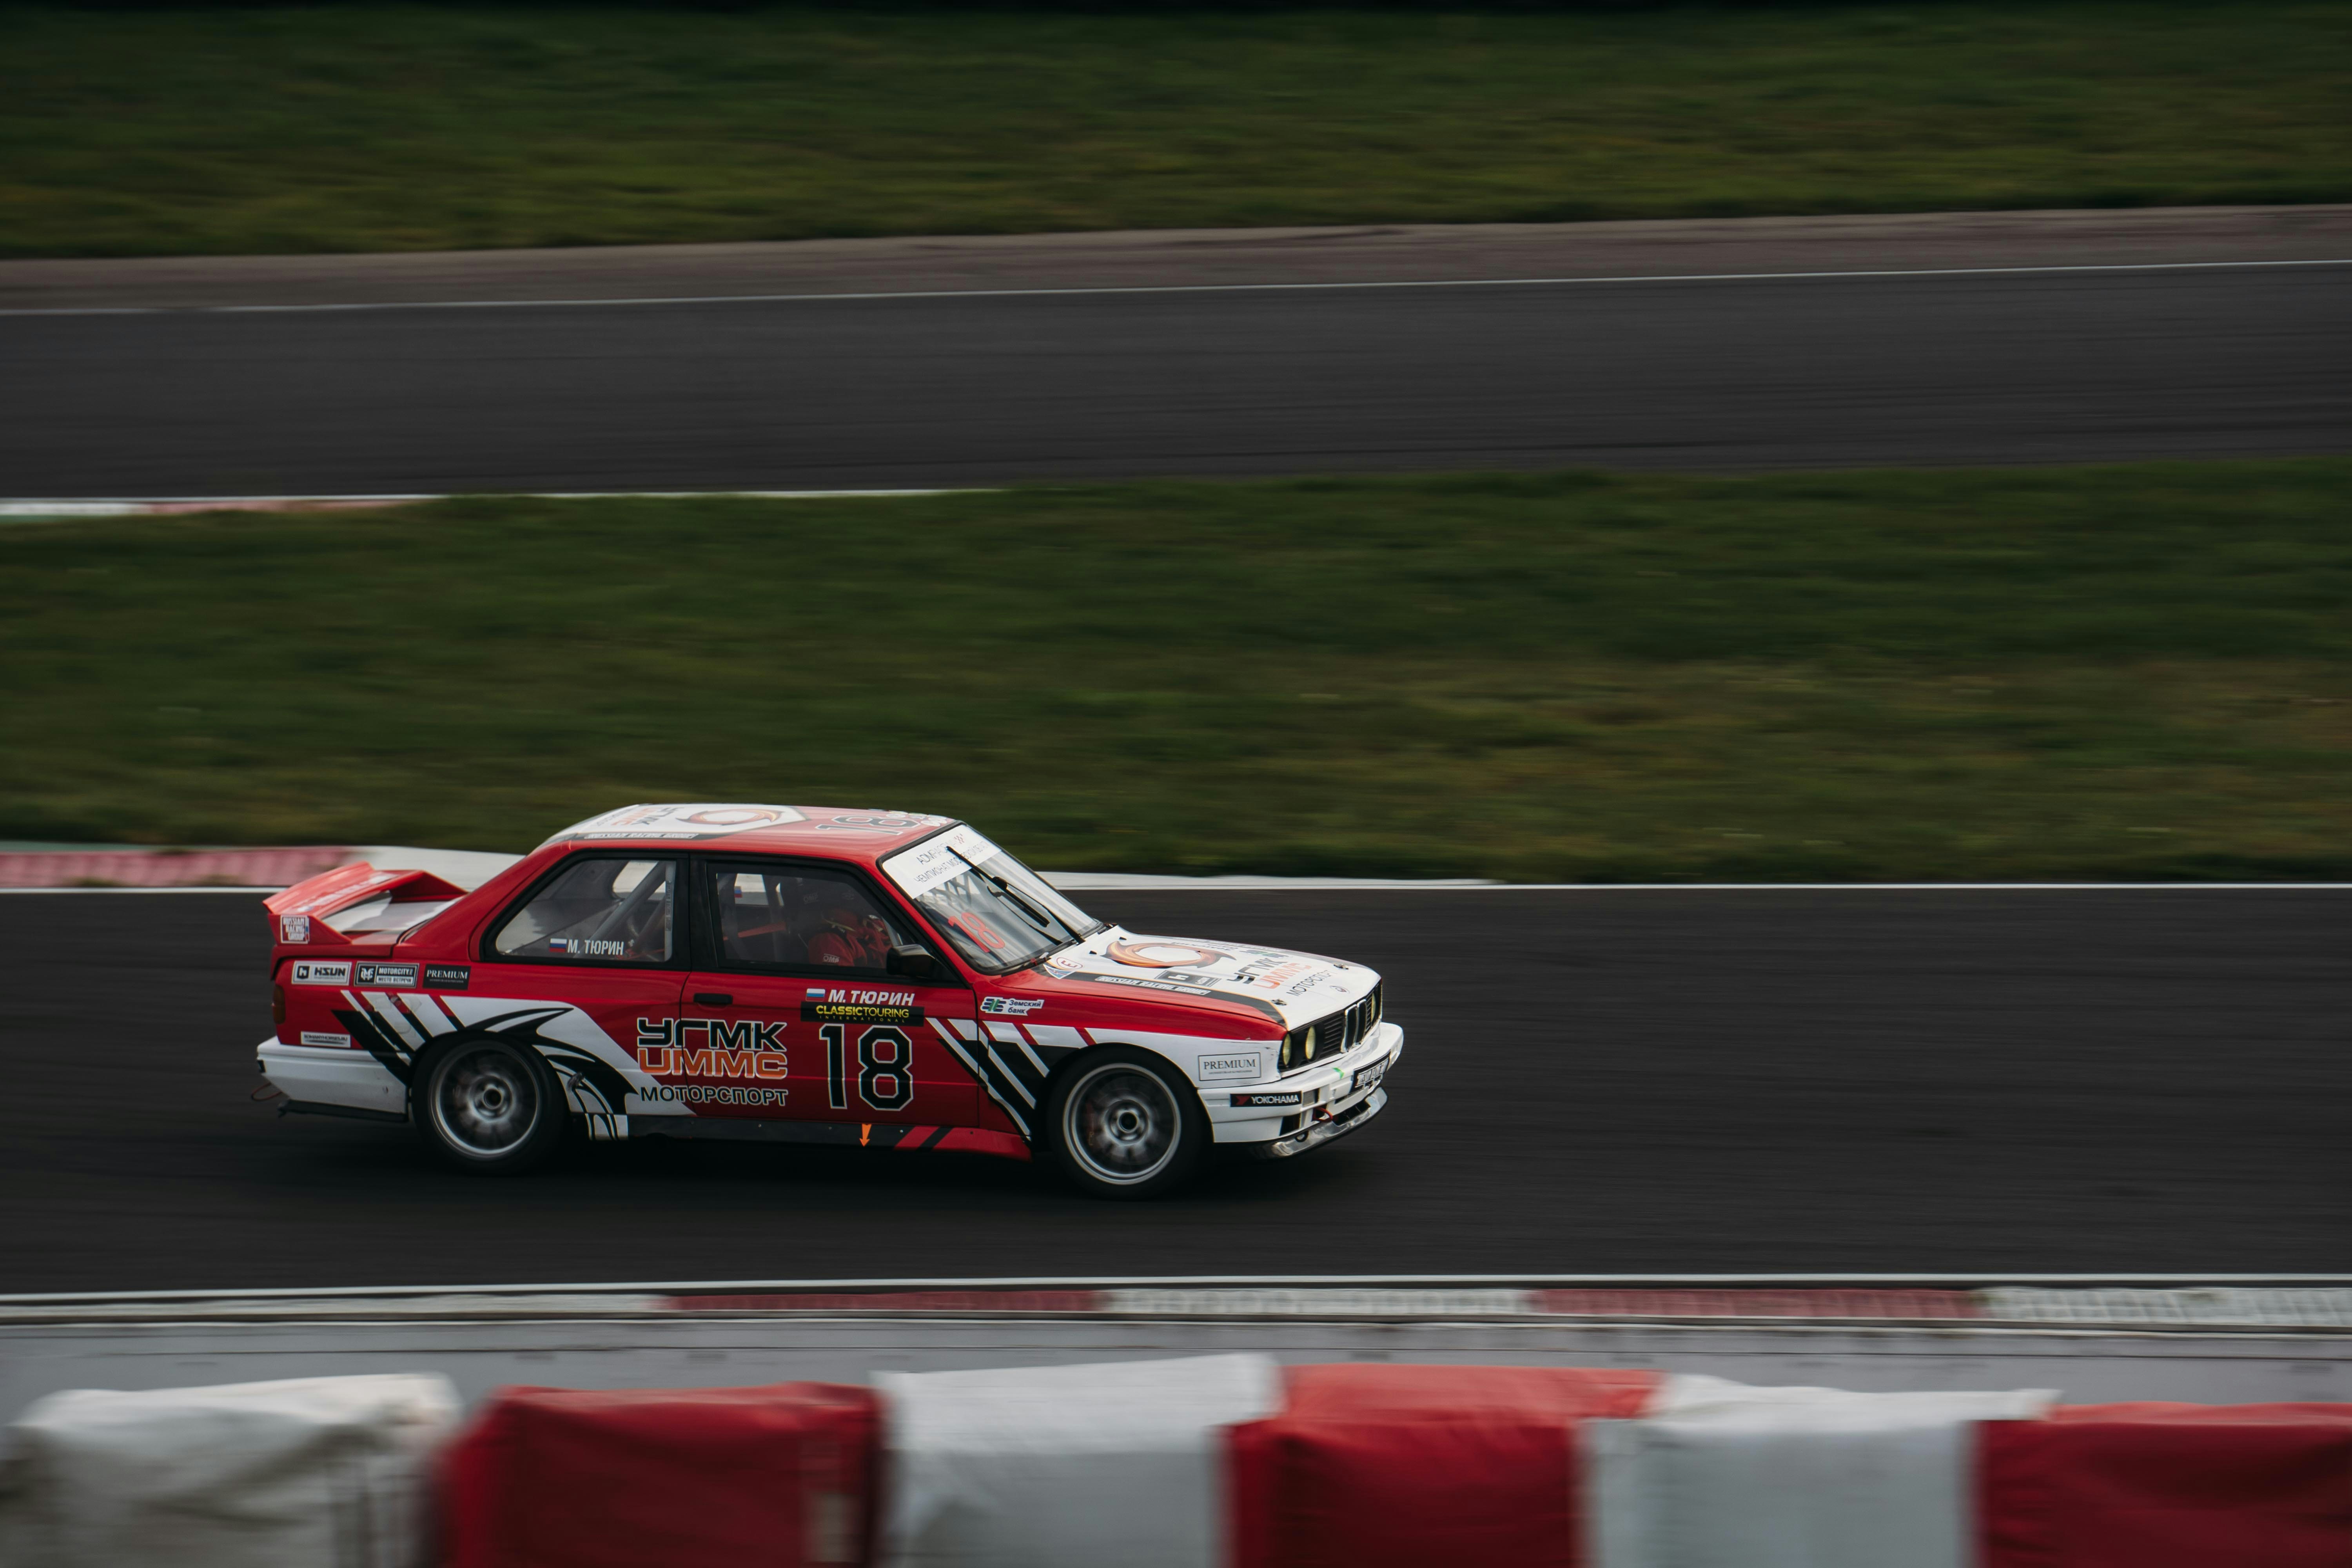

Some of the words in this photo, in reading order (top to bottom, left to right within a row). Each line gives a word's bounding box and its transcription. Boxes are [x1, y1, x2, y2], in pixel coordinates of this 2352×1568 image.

[815, 815, 920, 835] 18
[947, 912, 1005, 953] 18
[568, 939, 580, 953] М.
[584, 939, 624, 955] ТЮРИН
[426, 969, 468, 979] PREMIUM
[828, 989, 846, 1003] М.
[851, 990, 915, 1006] ТЮРИН
[816, 1005, 909, 1018] CLASSICTOURING
[637, 1018, 787, 1052] УГМК
[638, 1048, 788, 1079] UMMC
[819, 1023, 914, 1111] 18
[1203, 1059, 1256, 1070] PREMIUM
[640, 1086, 788, 1106] МОТОРСПОРТ
[1251, 1094, 1299, 1104] YOKOHAMA
